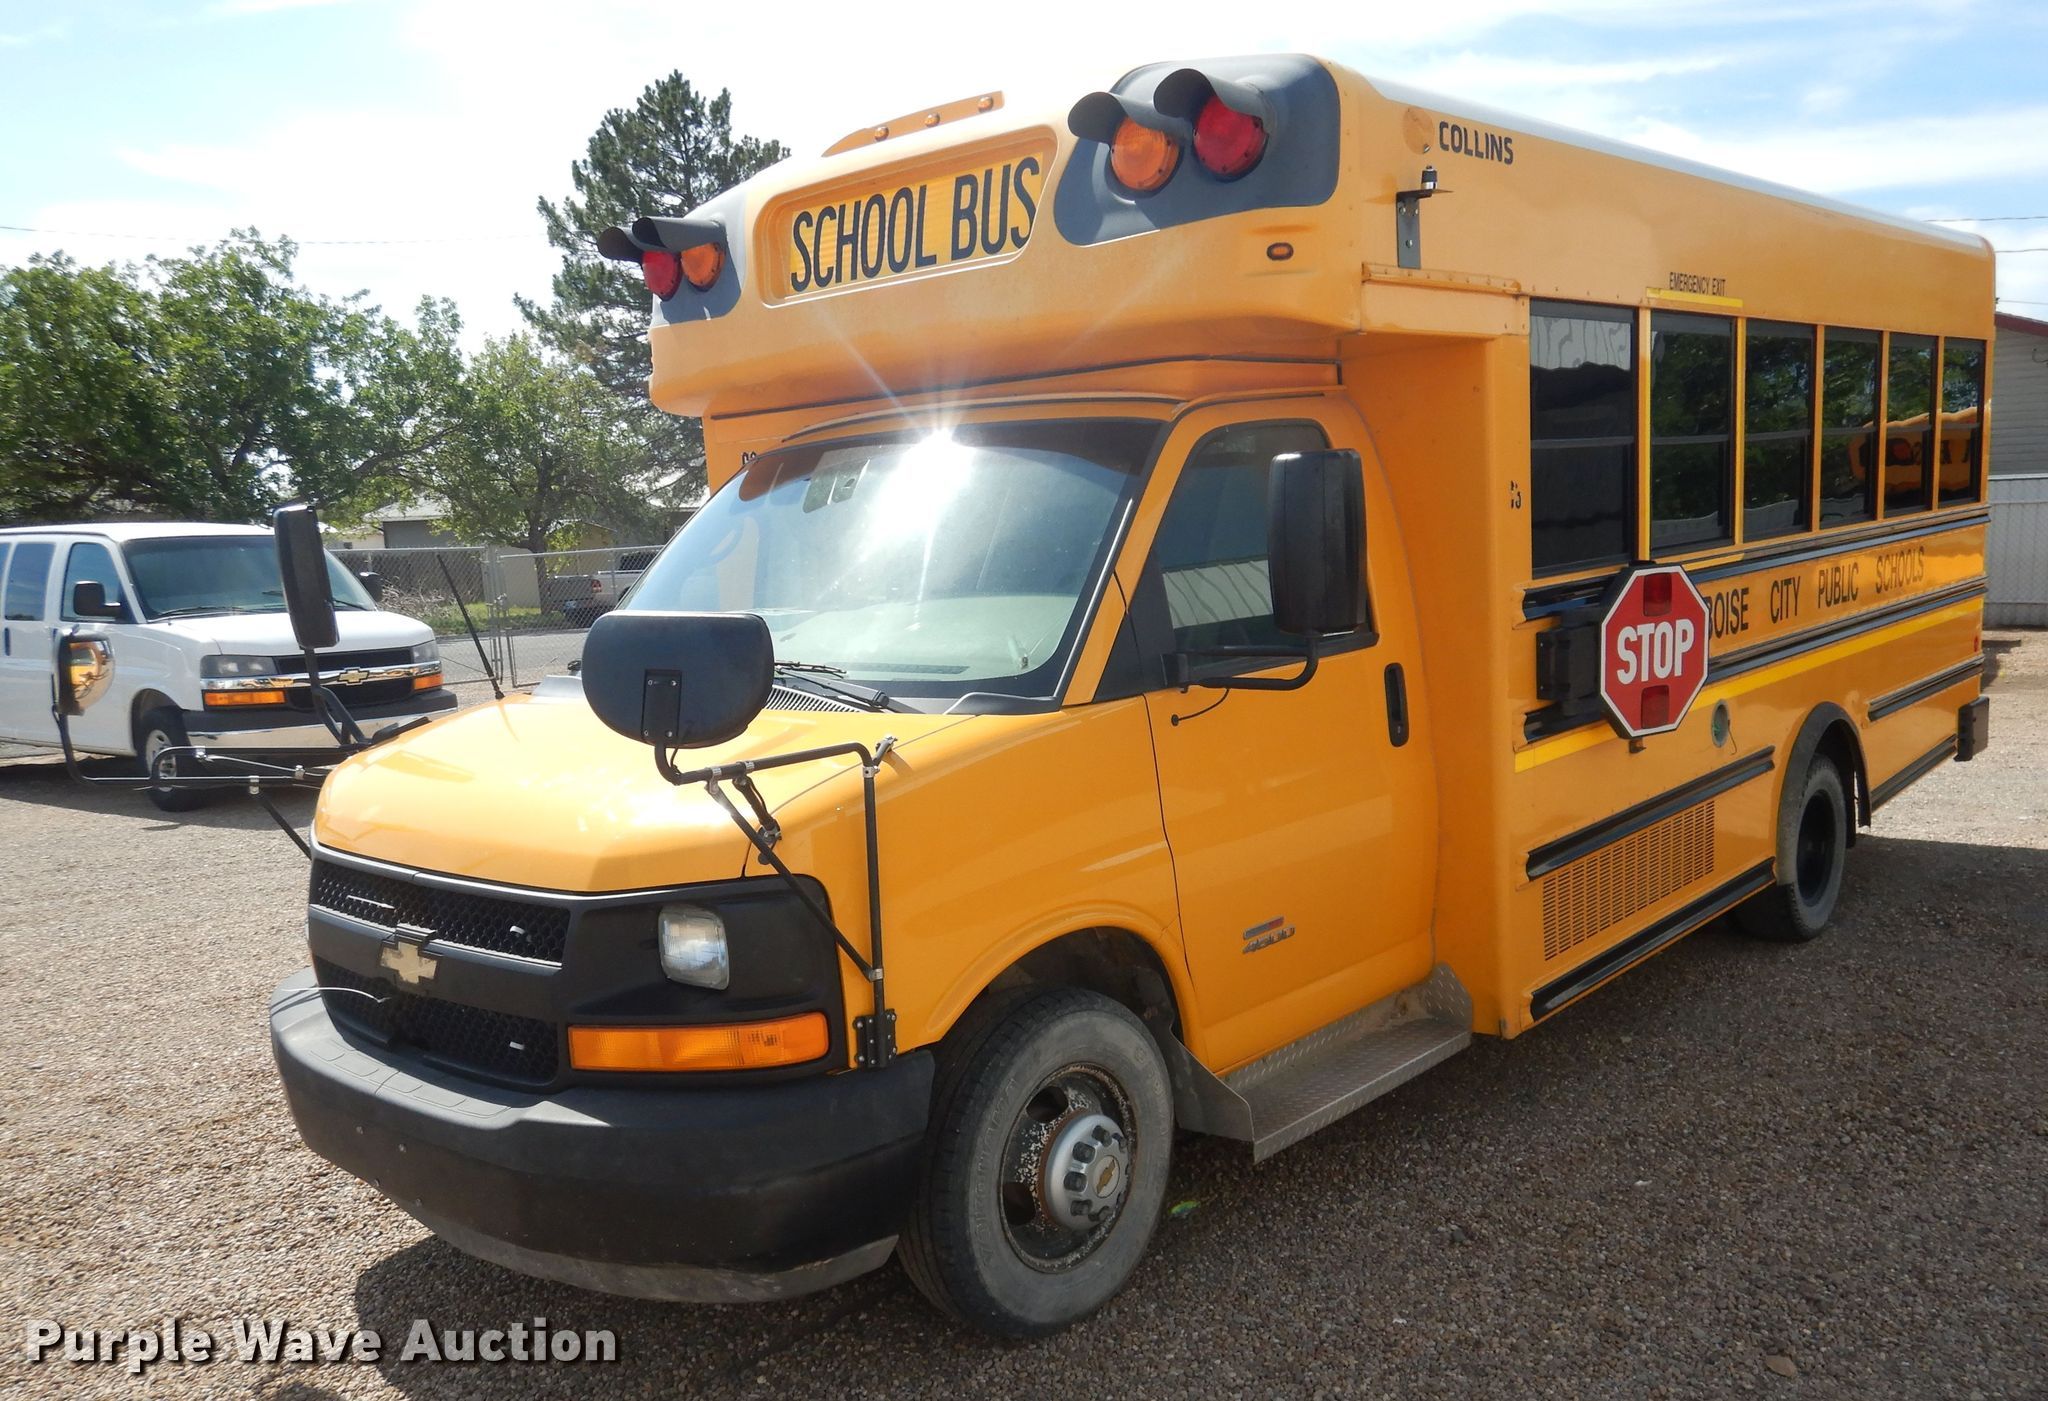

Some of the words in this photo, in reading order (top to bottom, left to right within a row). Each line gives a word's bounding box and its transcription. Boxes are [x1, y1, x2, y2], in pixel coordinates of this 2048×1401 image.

[1439, 121, 1514, 165] COLLINS
[791, 184, 937, 292] SCHOOL
[951, 157, 1040, 260] BUS
[1669, 271, 1710, 296] EMERGENCY
[1712, 278, 1727, 297] EXIT
[1770, 576, 1801, 624] CITY
[1818, 562, 1859, 608] PUBLIC
[1876, 546, 1925, 594] SCHOOLS
[1616, 618, 1695, 685] STOP
